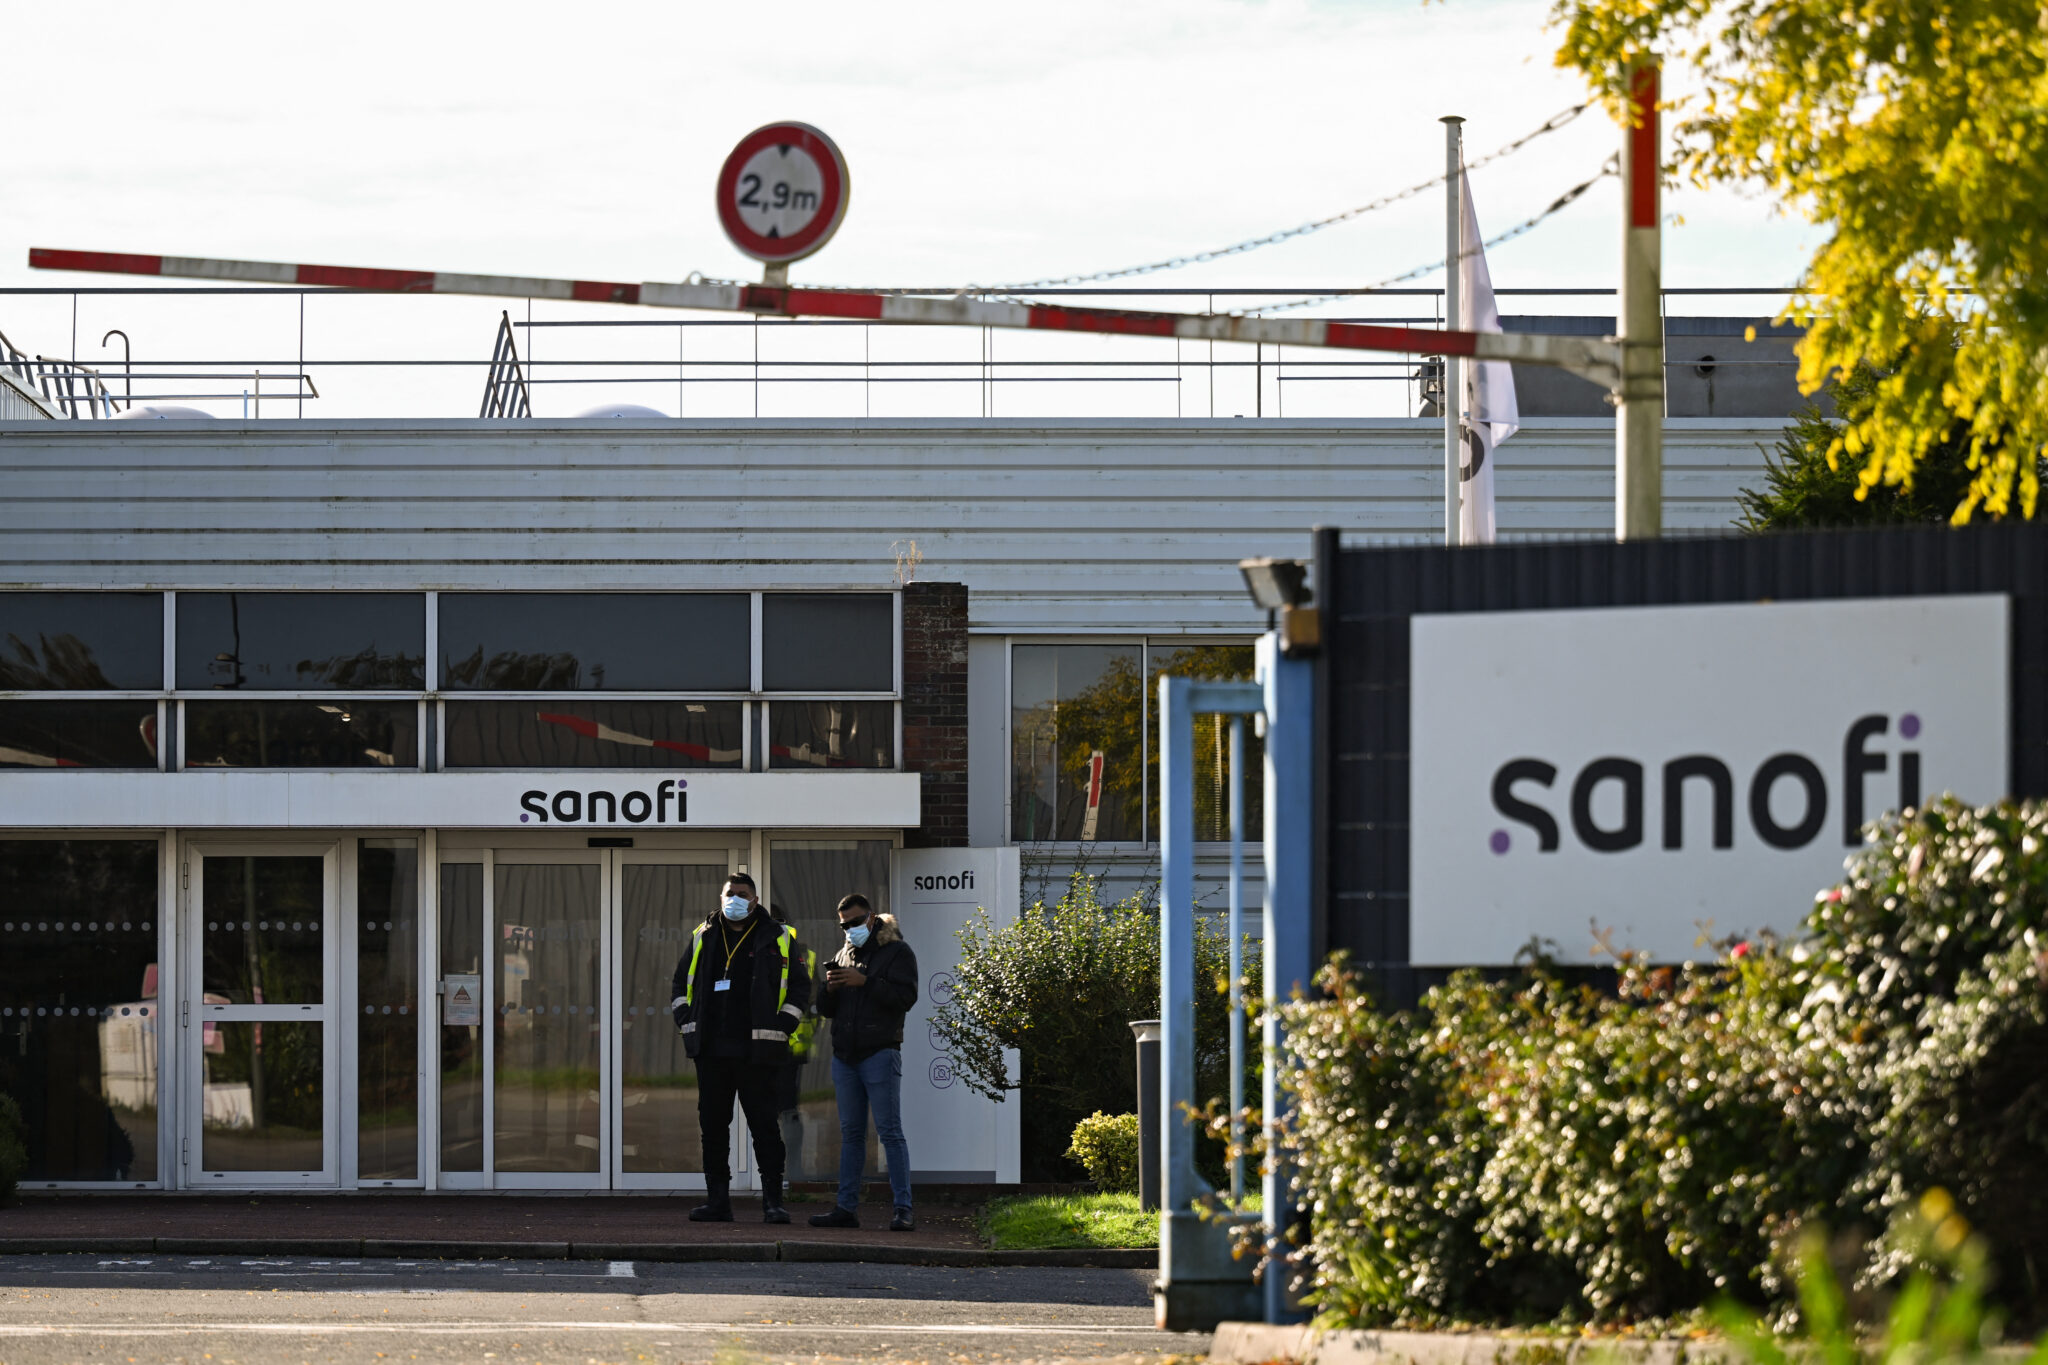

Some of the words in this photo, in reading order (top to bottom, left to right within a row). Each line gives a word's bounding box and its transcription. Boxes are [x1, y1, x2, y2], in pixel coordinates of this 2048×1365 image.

[738, 174, 818, 213] 2,9m
[519, 778, 688, 823] sanofi
[1489, 713, 1922, 856] sanofi
[914, 870, 974, 890] sanofi
